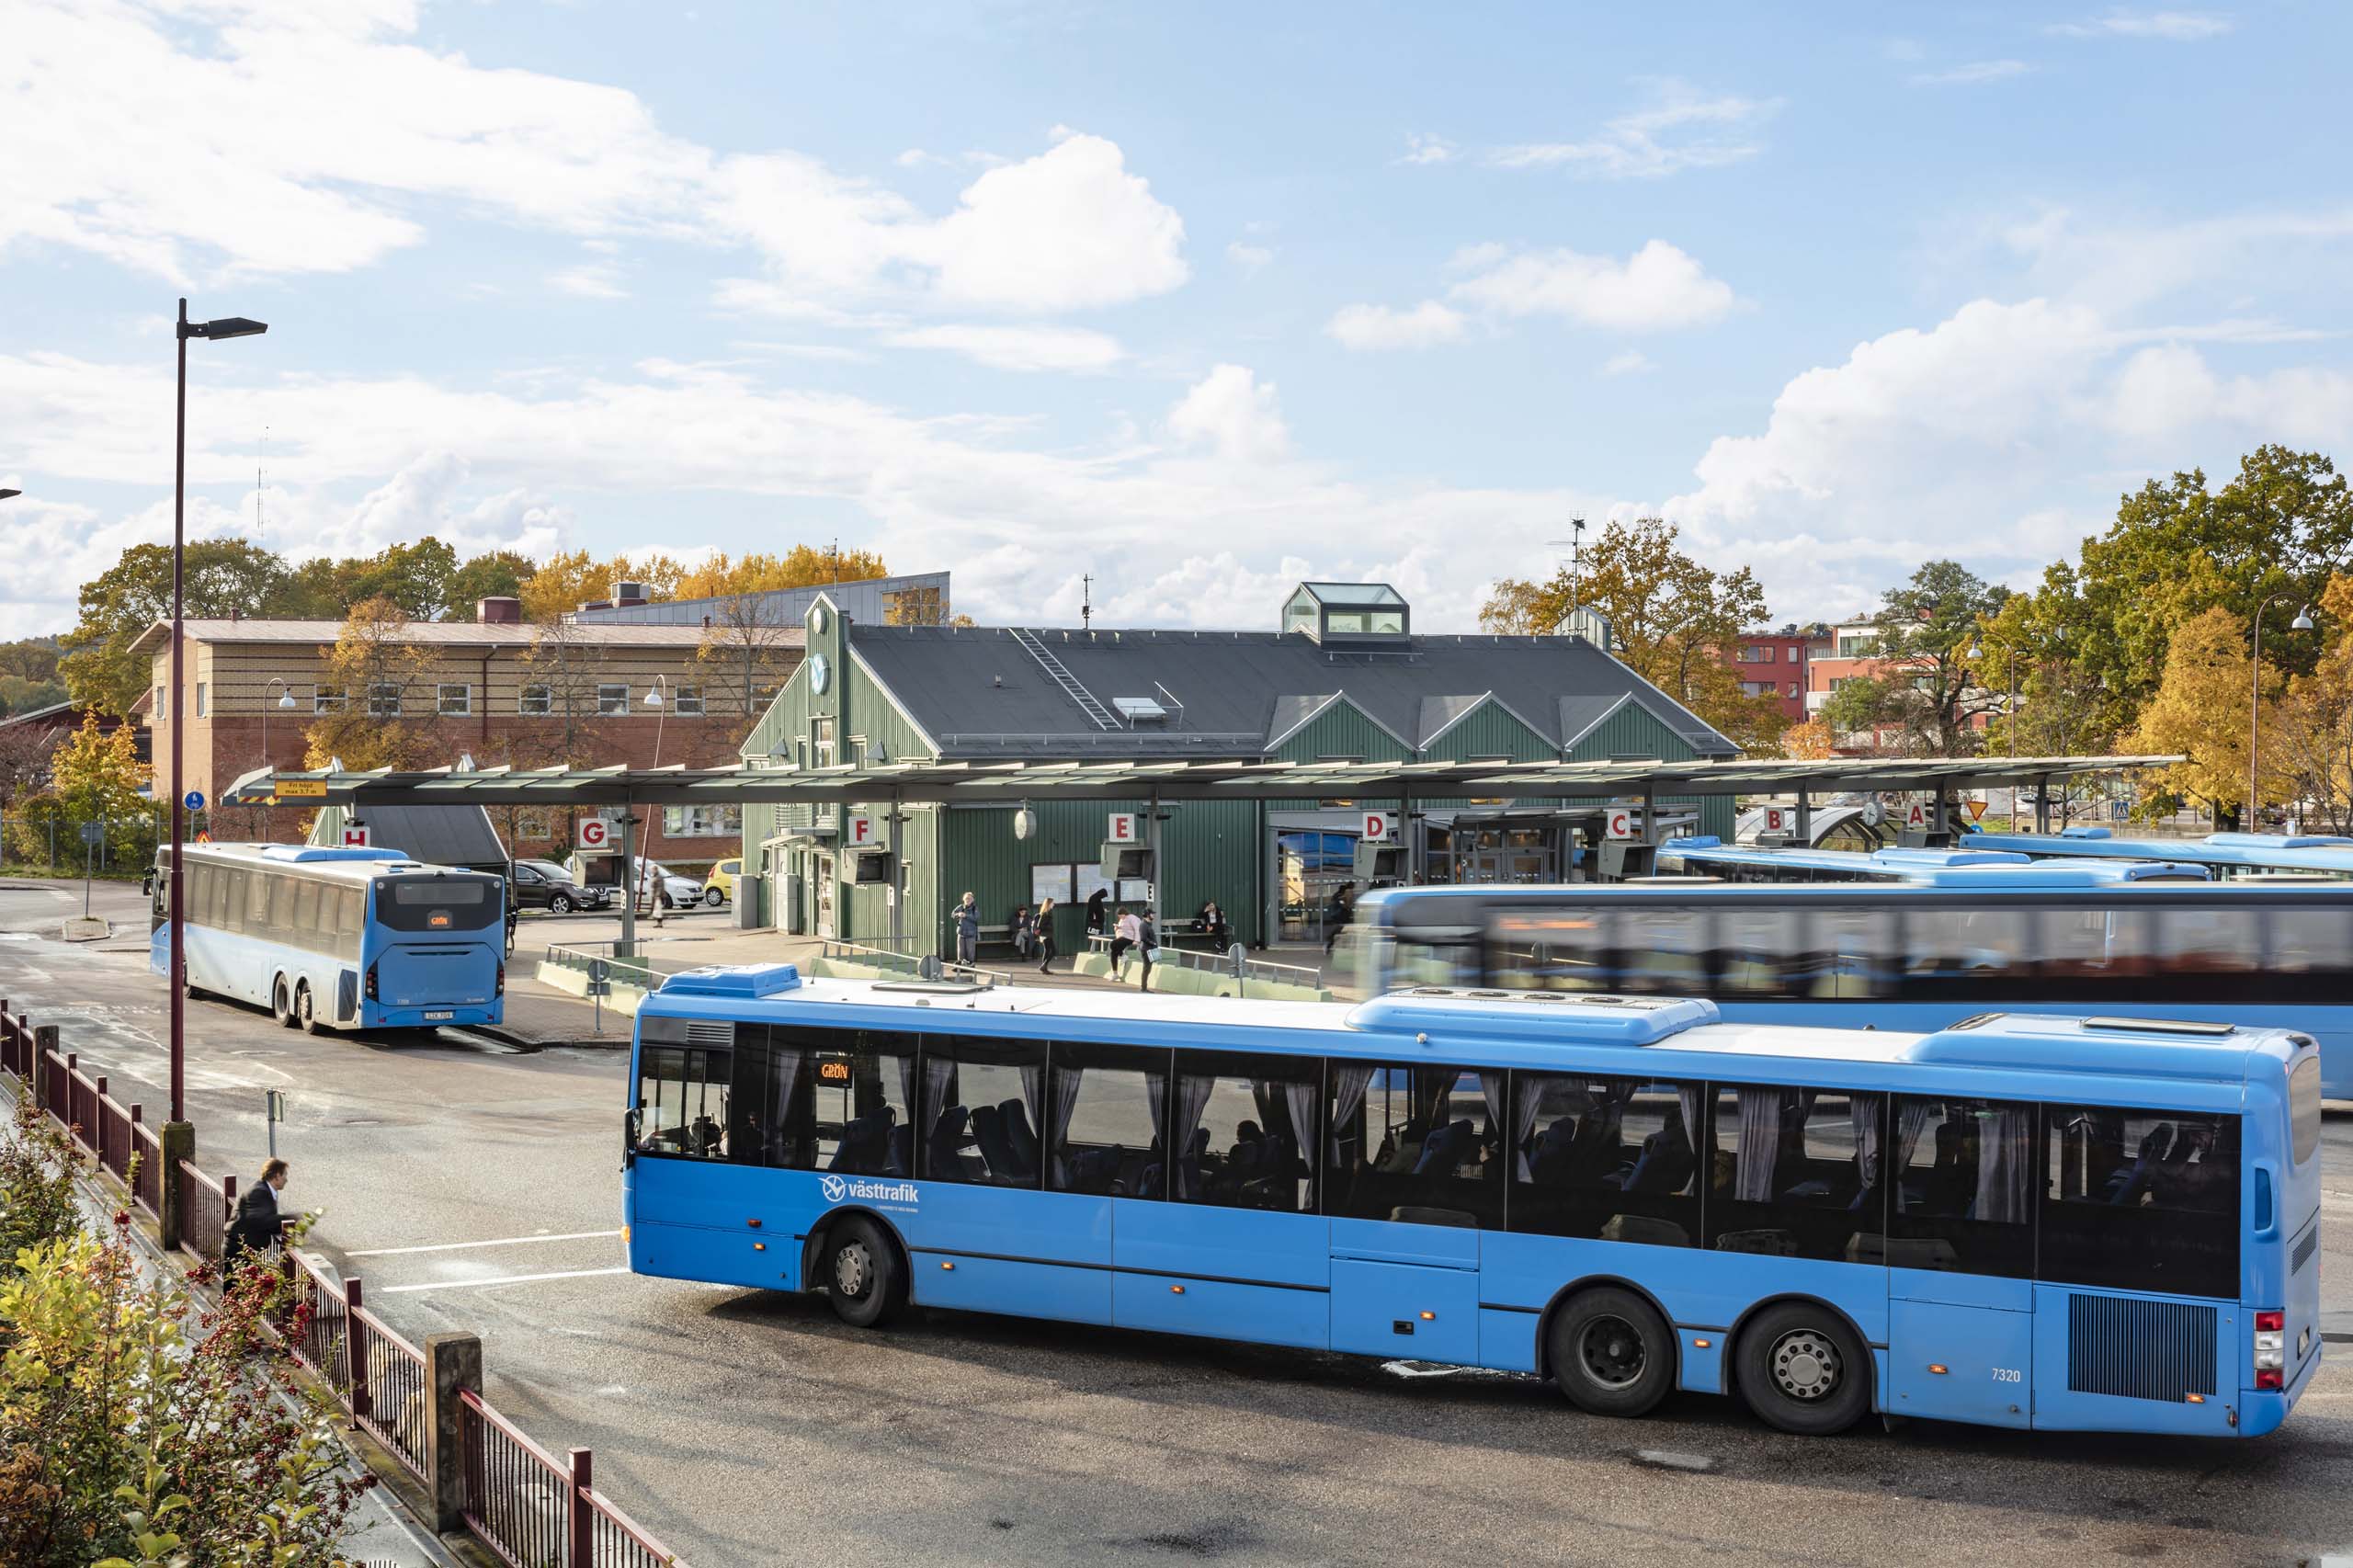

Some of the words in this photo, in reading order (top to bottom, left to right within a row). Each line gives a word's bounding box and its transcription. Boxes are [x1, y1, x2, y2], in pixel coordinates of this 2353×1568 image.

[1612, 814, 1626, 835] C
[1768, 810, 1781, 830] B
[1909, 805, 1925, 824] A
[583, 823, 605, 844] G
[856, 820, 869, 842] F
[1116, 817, 1129, 838] E
[1367, 816, 1383, 836] D
[346, 830, 366, 846] H
[822, 1062, 847, 1079] GRÖN
[847, 1180, 919, 1203] västtrafik
[1992, 1368, 2021, 1383] 7320
